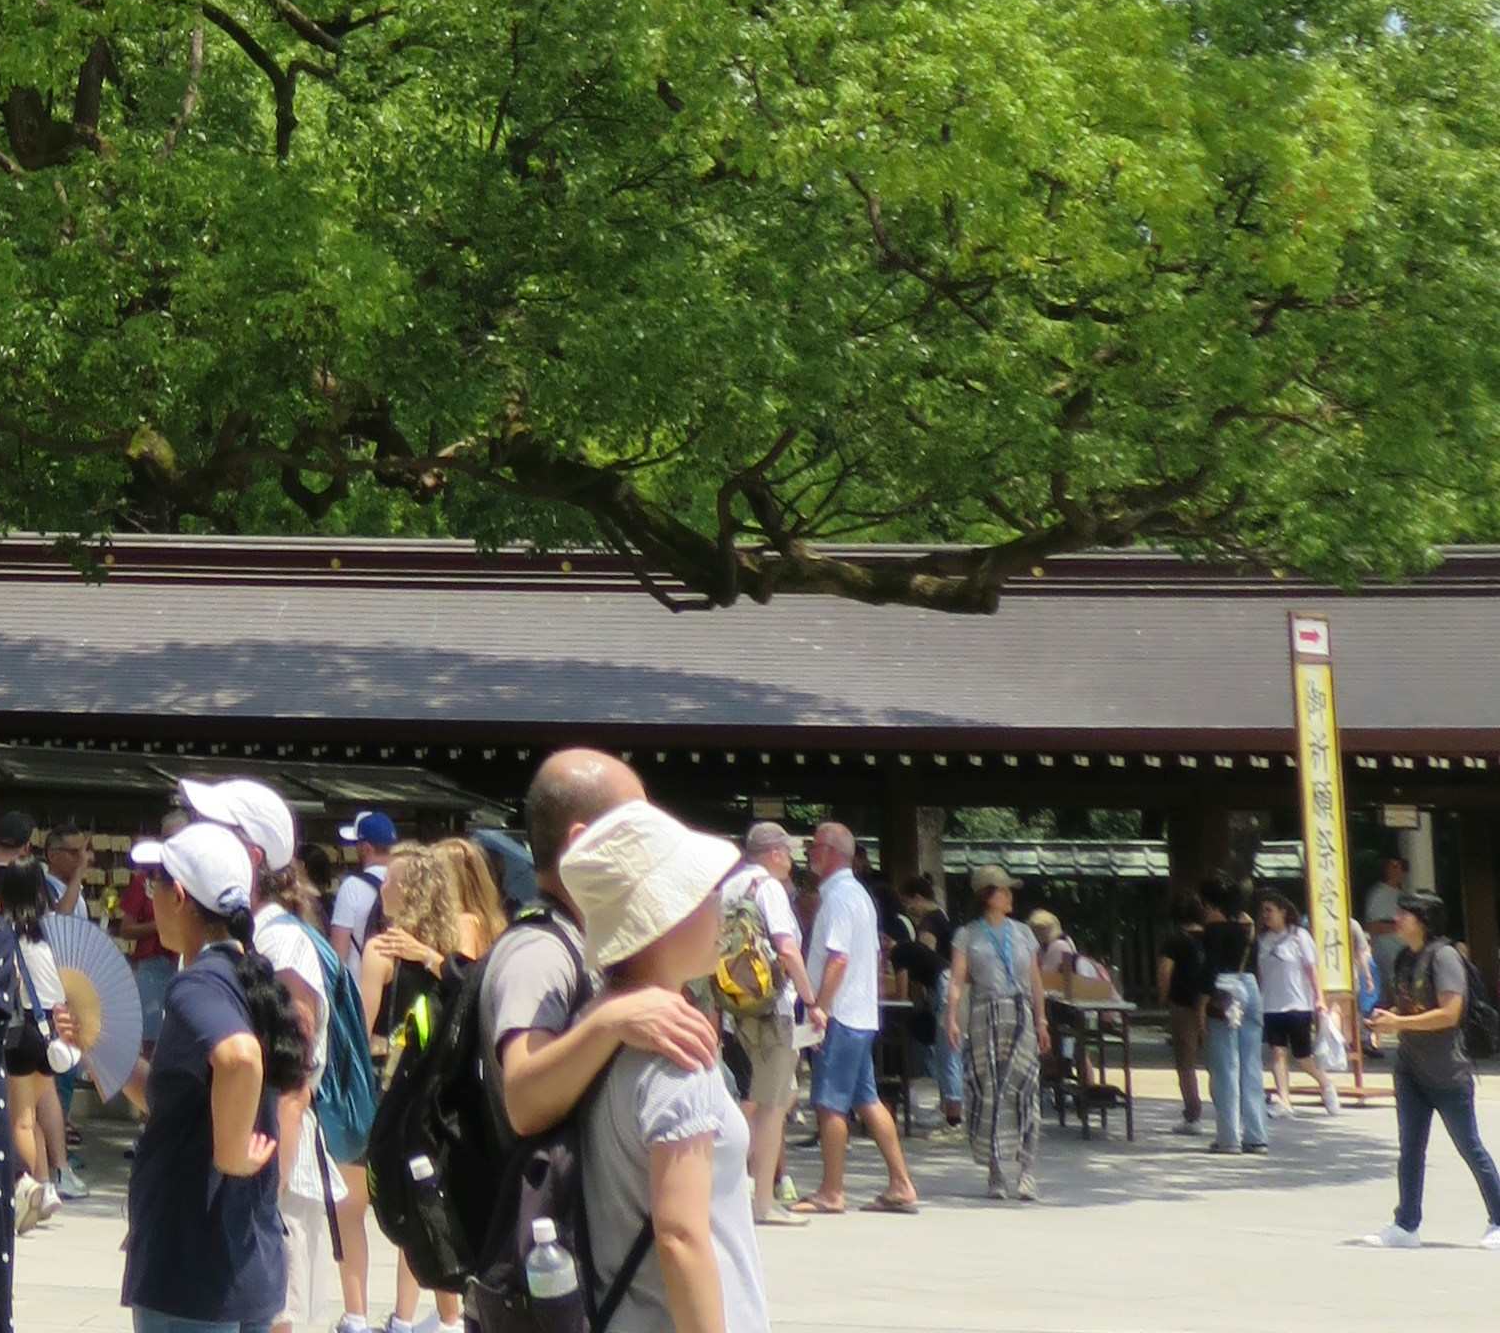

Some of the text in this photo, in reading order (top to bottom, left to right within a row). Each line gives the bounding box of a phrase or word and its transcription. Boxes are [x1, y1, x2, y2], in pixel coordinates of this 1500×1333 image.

[1305, 678, 1342, 973] 御祈願祭受付
